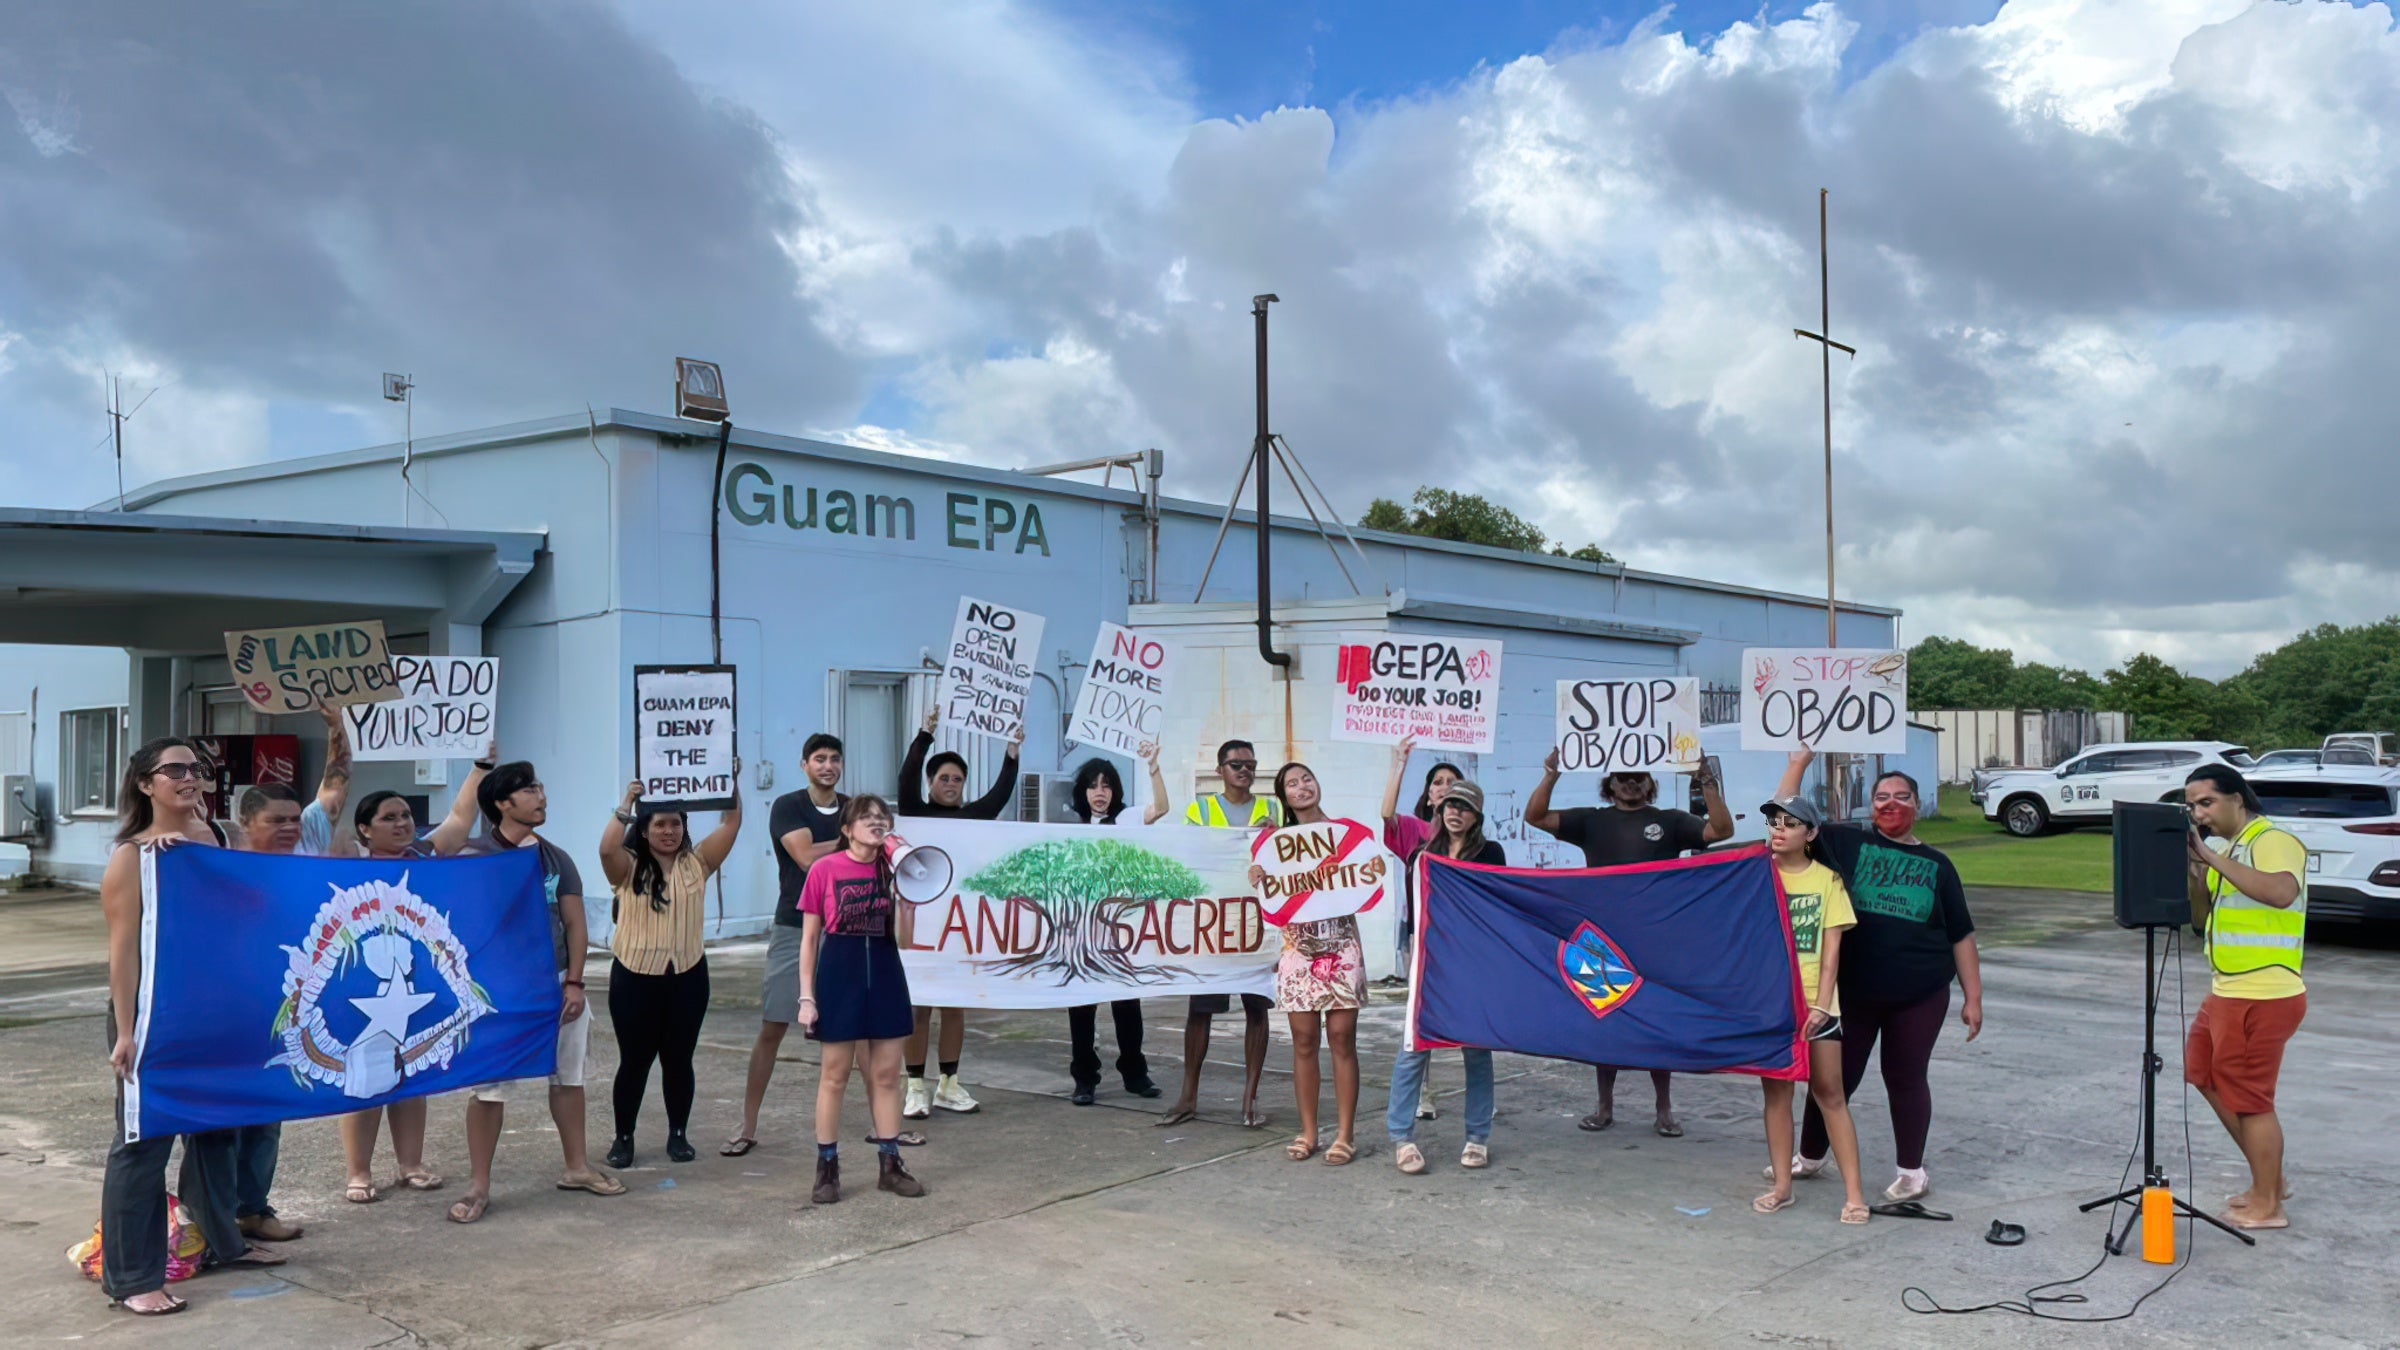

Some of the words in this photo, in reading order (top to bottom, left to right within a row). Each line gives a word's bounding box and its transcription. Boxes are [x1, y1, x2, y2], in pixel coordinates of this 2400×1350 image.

[724, 462, 915, 540] Guam
[945, 491, 1052, 558] EPA
[966, 602, 1016, 632] NO
[263, 627, 372, 673] LAND
[965, 627, 1017, 661] OPEN
[1111, 630, 1164, 670] NO
[395, 656, 440, 696] PA
[447, 660, 494, 697] DO
[949, 666, 973, 684] ON
[1090, 658, 1162, 695] MORE
[1371, 641, 1466, 685] GEPA
[1792, 656, 1867, 681] STOP
[698, 696, 731, 711] EPA
[953, 684, 1025, 720] STOLEN
[1087, 681, 1163, 736] TOXIC
[1358, 685, 1381, 703] DO
[1384, 686, 1428, 708] YOUR
[1432, 688, 1482, 713] JOB!
[1568, 679, 1677, 731] STOP
[1761, 684, 1896, 746] OB/OD
[346, 703, 429, 751] YOUR
[426, 702, 491, 738] JOB
[656, 719, 715, 738] DENY
[948, 700, 1018, 737] LAND!
[663, 748, 708, 767] THE
[1561, 721, 1673, 773] OB/OD!
[649, 774, 731, 796] PERMIT
[1274, 826, 1337, 863] BAN
